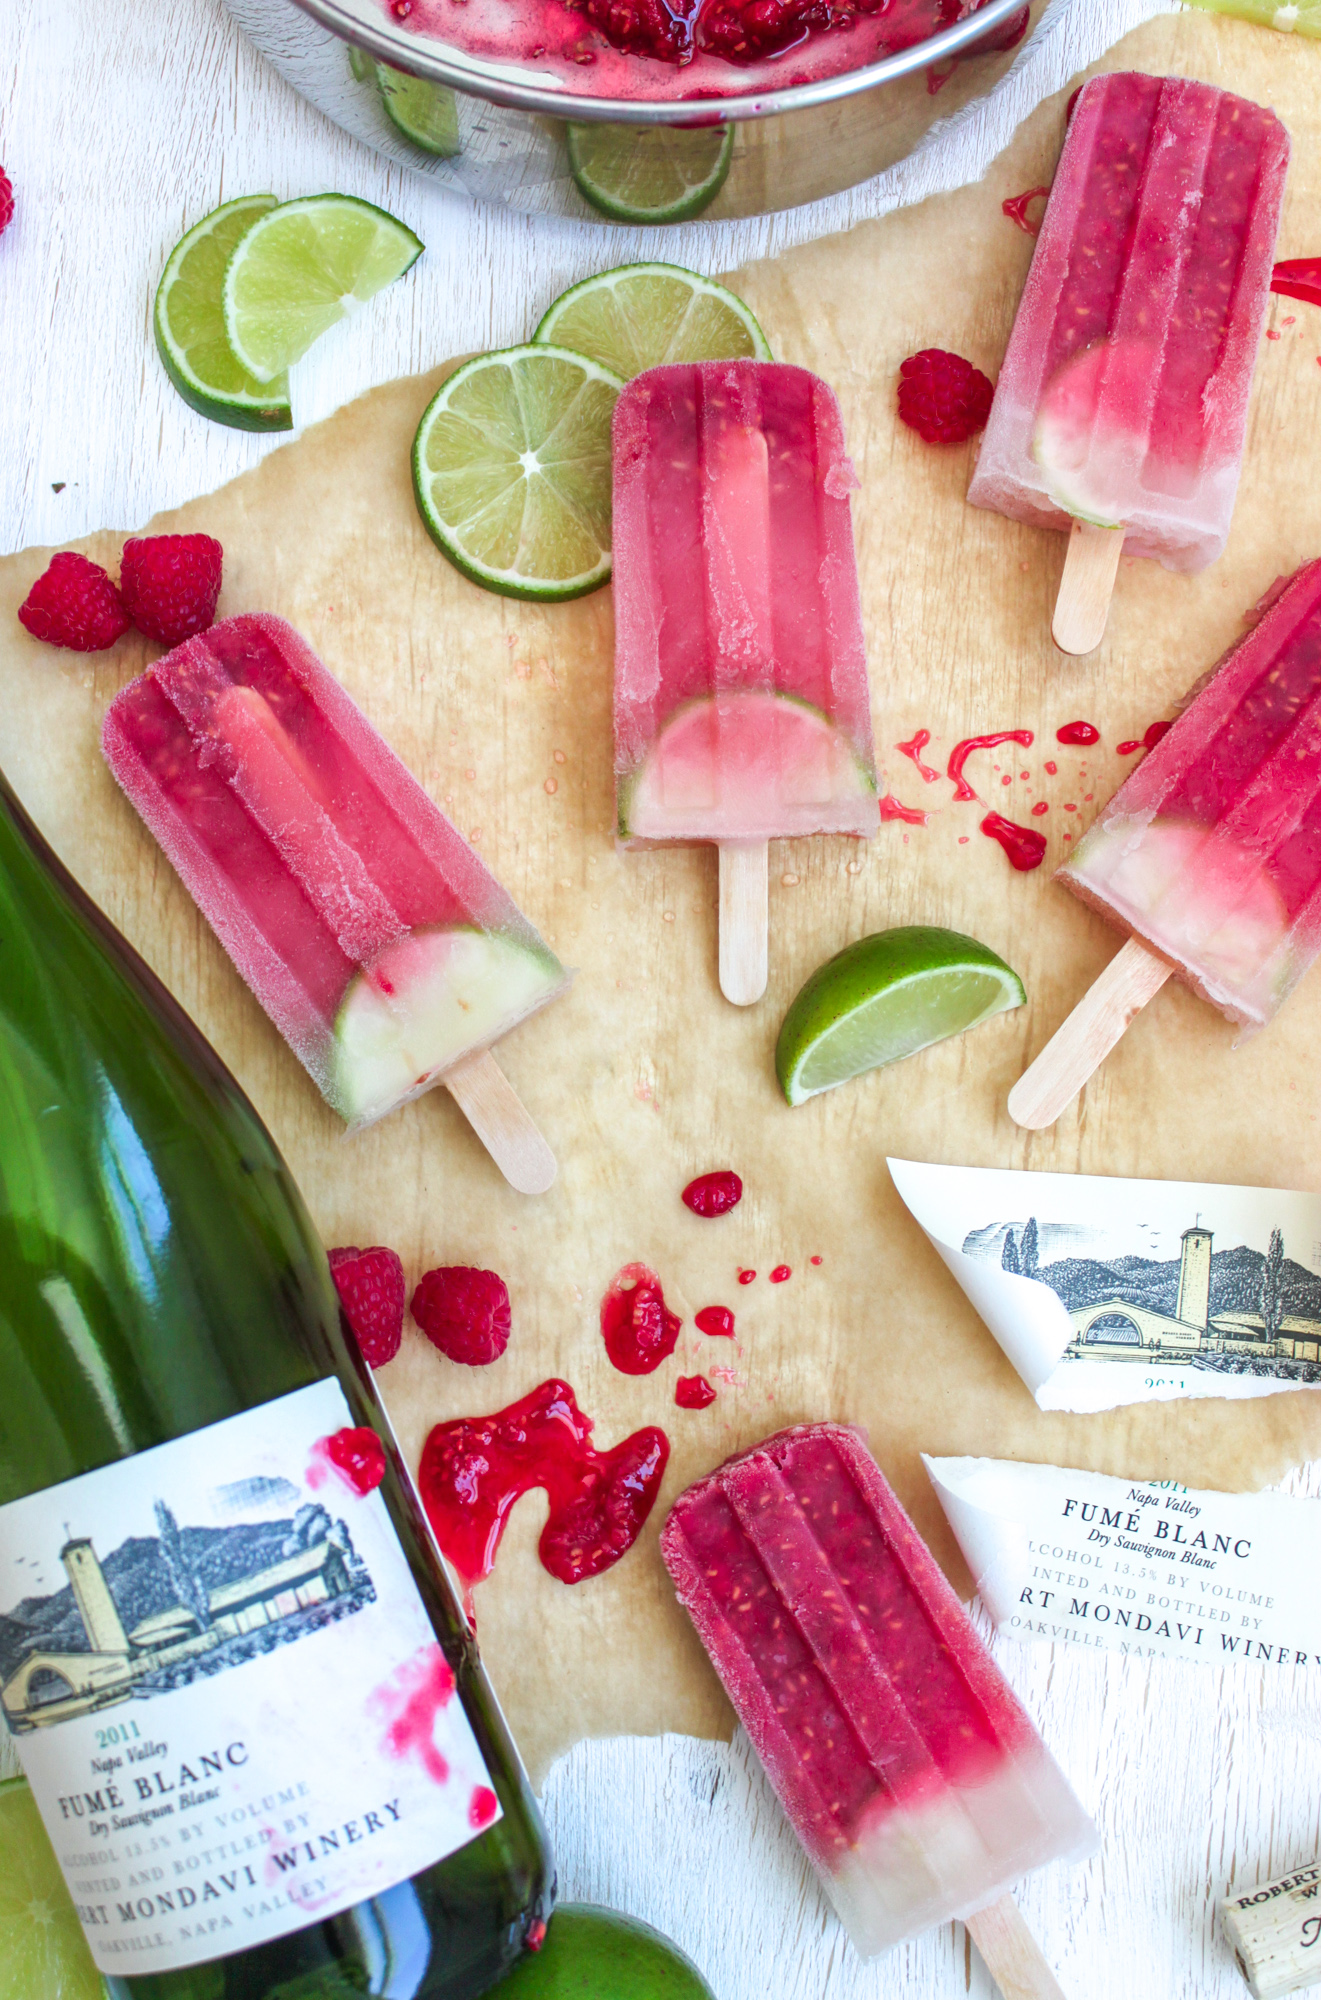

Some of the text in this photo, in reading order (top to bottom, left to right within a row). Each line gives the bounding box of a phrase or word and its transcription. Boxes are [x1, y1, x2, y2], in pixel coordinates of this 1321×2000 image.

[1062, 1499, 1252, 1558] FUMÉ BLANC
[1126, 1488, 1201, 1519] Napa Valley
[1087, 1528, 1217, 1570] Dry Sauvignon Blanc
[1099, 1583, 1136, 1600] AND
[1146, 1593, 1231, 1623] BOTTLED
[1240, 1615, 1263, 1630] BY
[1114, 1561, 1157, 1581] 13.5%
[1167, 1573, 1189, 1588] BY
[1200, 1581, 1274, 1609] VOLUME
[1019, 1586, 1055, 1608] RT
[1069, 1598, 1204, 1645] MONDAVI
[90, 1739, 168, 1776] Napa Valley
[95, 1719, 142, 1749] 2011
[58, 1741, 249, 1818] FUMÉ BLANC
[89, 1786, 221, 1839] Dry Sauvignon Blanc
[179, 1822, 203, 1842] BY
[215, 1781, 310, 1828] VOLUME
[117, 1865, 258, 1923] MONDAVI
[271, 1798, 401, 1872] WINERY
[128, 1866, 165, 1888] AND
[173, 1828, 273, 1875] BOTTLED
[283, 1812, 310, 1834] BY
[179, 1914, 233, 1941] NAPA
[243, 1877, 329, 1919] VALLEY
[1237, 1869, 1319, 1909] ROBERT
